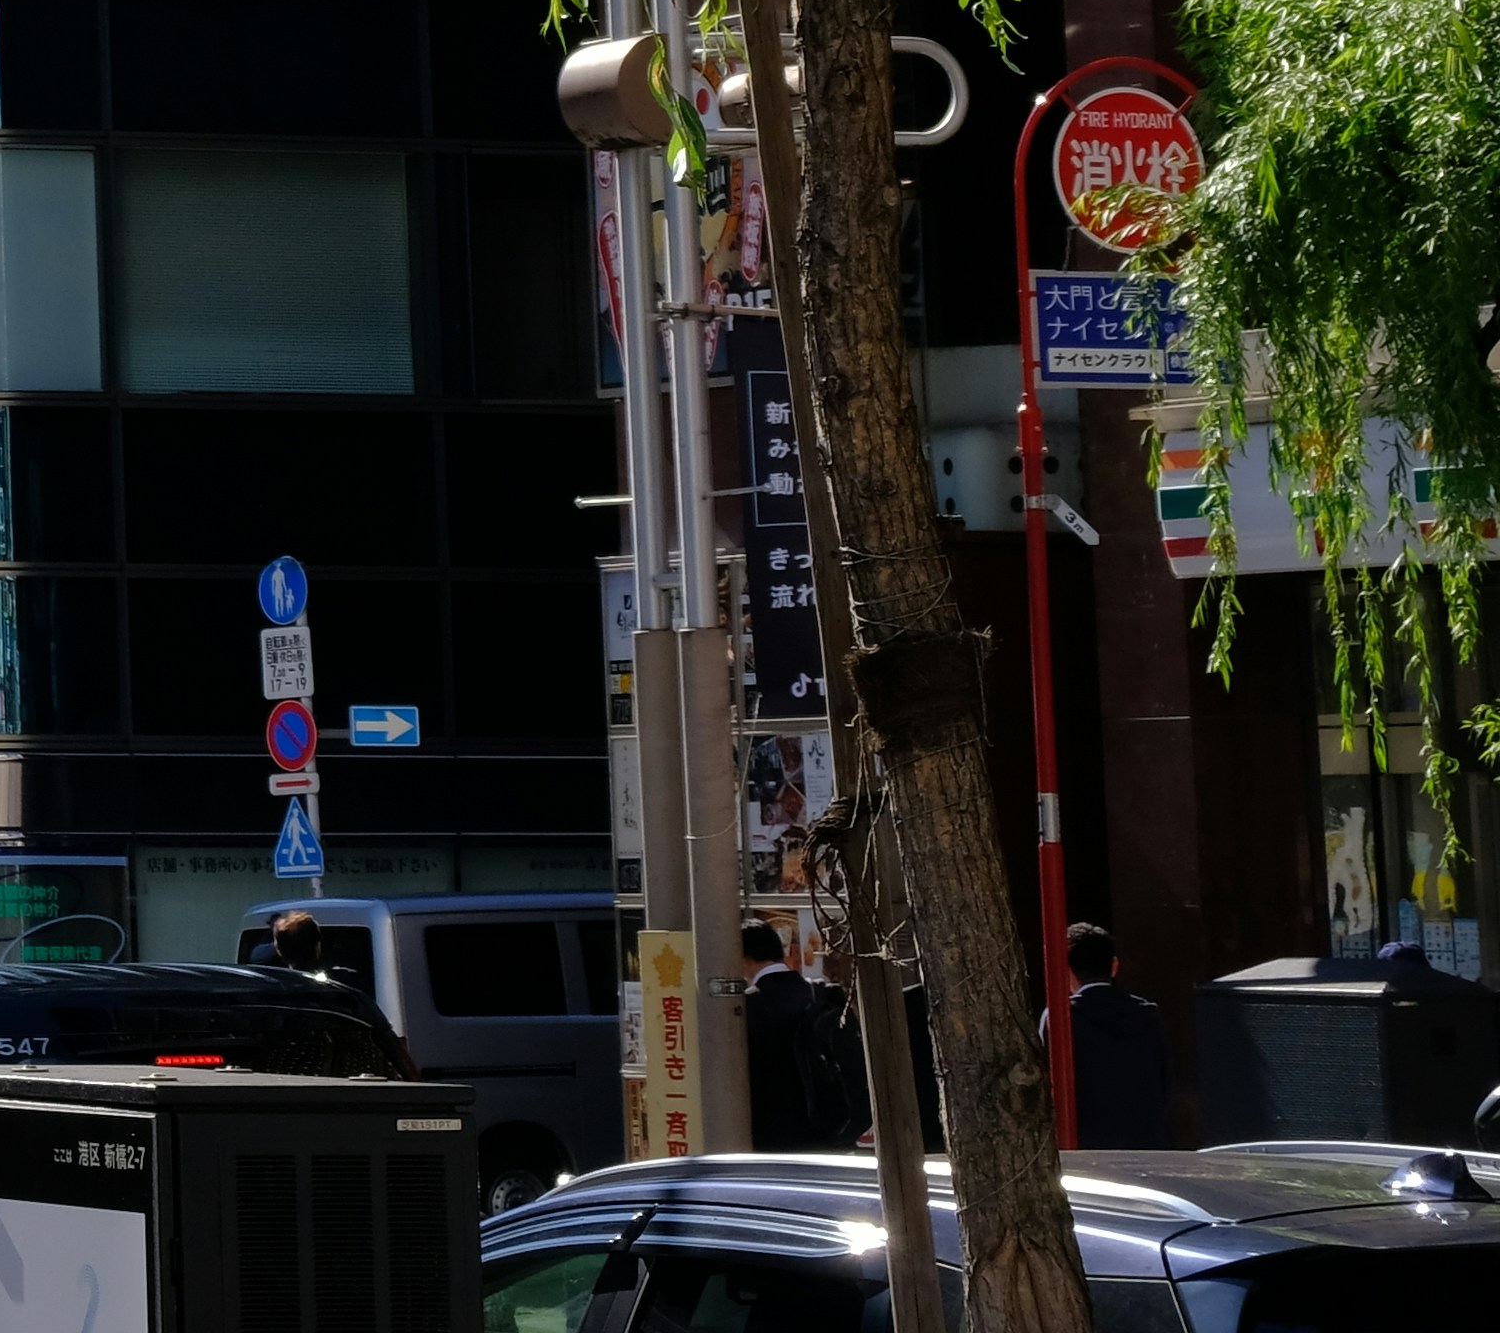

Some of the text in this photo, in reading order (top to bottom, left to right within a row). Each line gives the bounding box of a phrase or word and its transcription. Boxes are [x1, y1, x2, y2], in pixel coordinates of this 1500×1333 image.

[1080, 110, 1175, 131] FIRE HYDRANT
[1070, 139, 1191, 198] 消火栓
[1060, 509, 1087, 534] 3m
[52, 1139, 148, 1172] ここは 港区 新橋2-7
